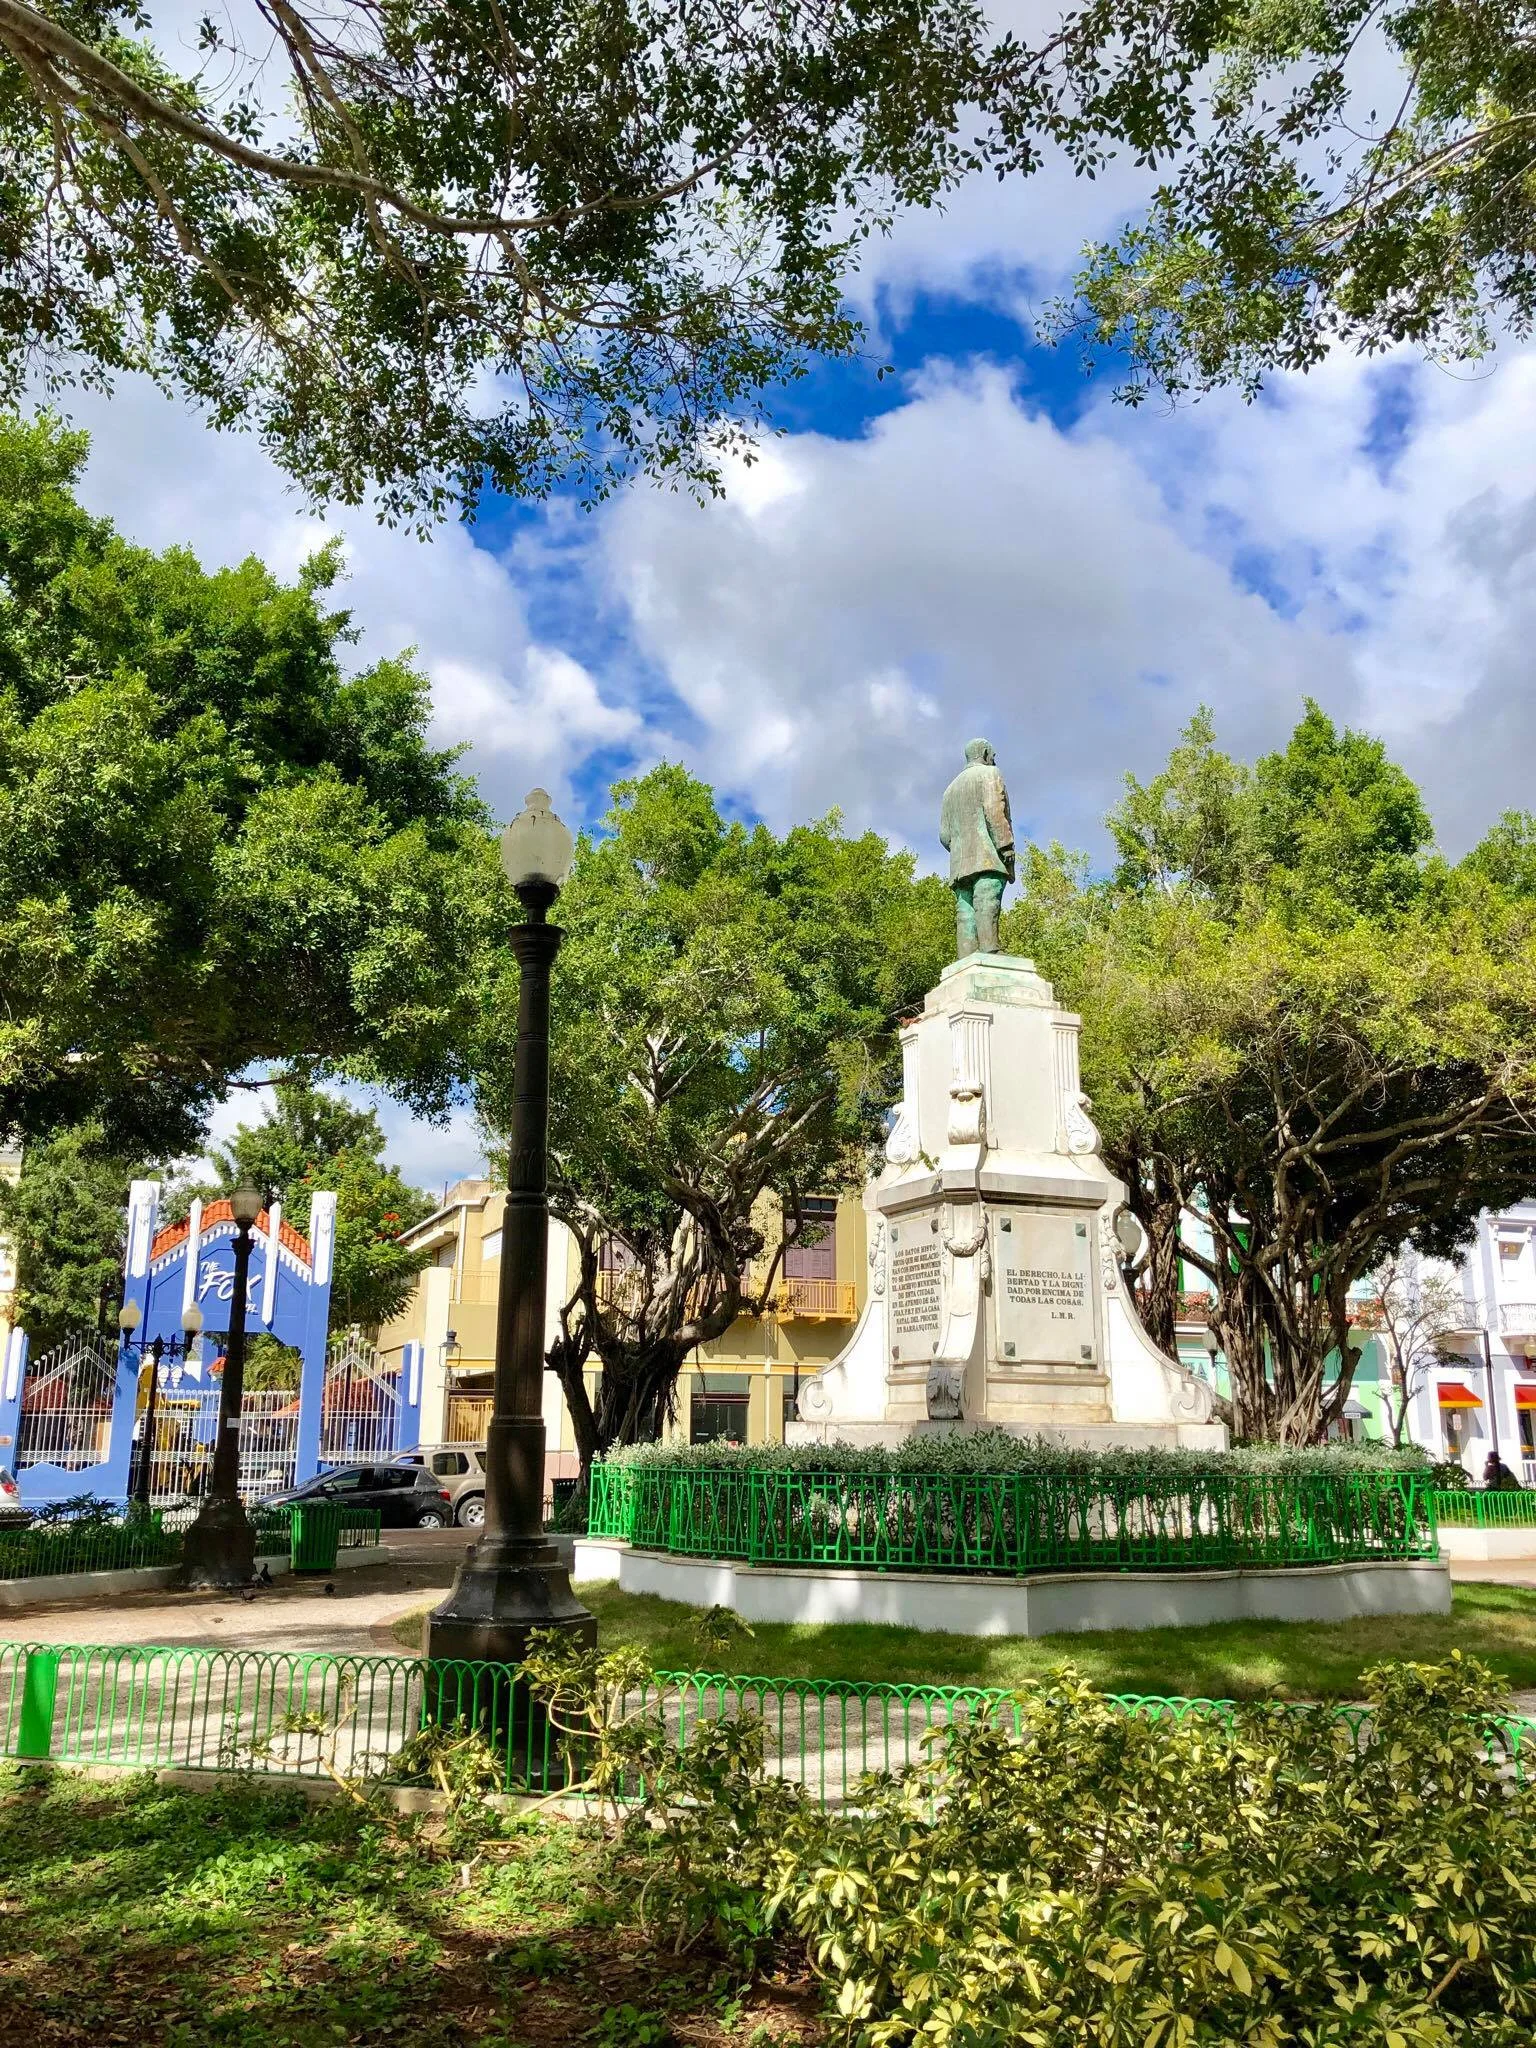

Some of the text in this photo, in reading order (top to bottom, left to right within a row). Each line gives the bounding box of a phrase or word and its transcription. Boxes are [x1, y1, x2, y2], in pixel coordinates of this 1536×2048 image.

[200, 1260, 220, 1272] THE
[905, 1256, 914, 1265] QUE
[1006, 1269, 1018, 1277] EL
[1061, 1271, 1072, 1280] LA
[1006, 1277, 1040, 1287] BERTAD
[1041, 1279, 1047, 1287] Y
[1049, 1280, 1060, 1288] LA
[1025, 1287, 1041, 1295] POR
[1041, 1288, 1072, 1297] ENCIMA
[1072, 1290, 1085, 1298] DE
[1009, 1295, 1037, 1304] TODAS
[1037, 1297, 1055, 1305] LAS
